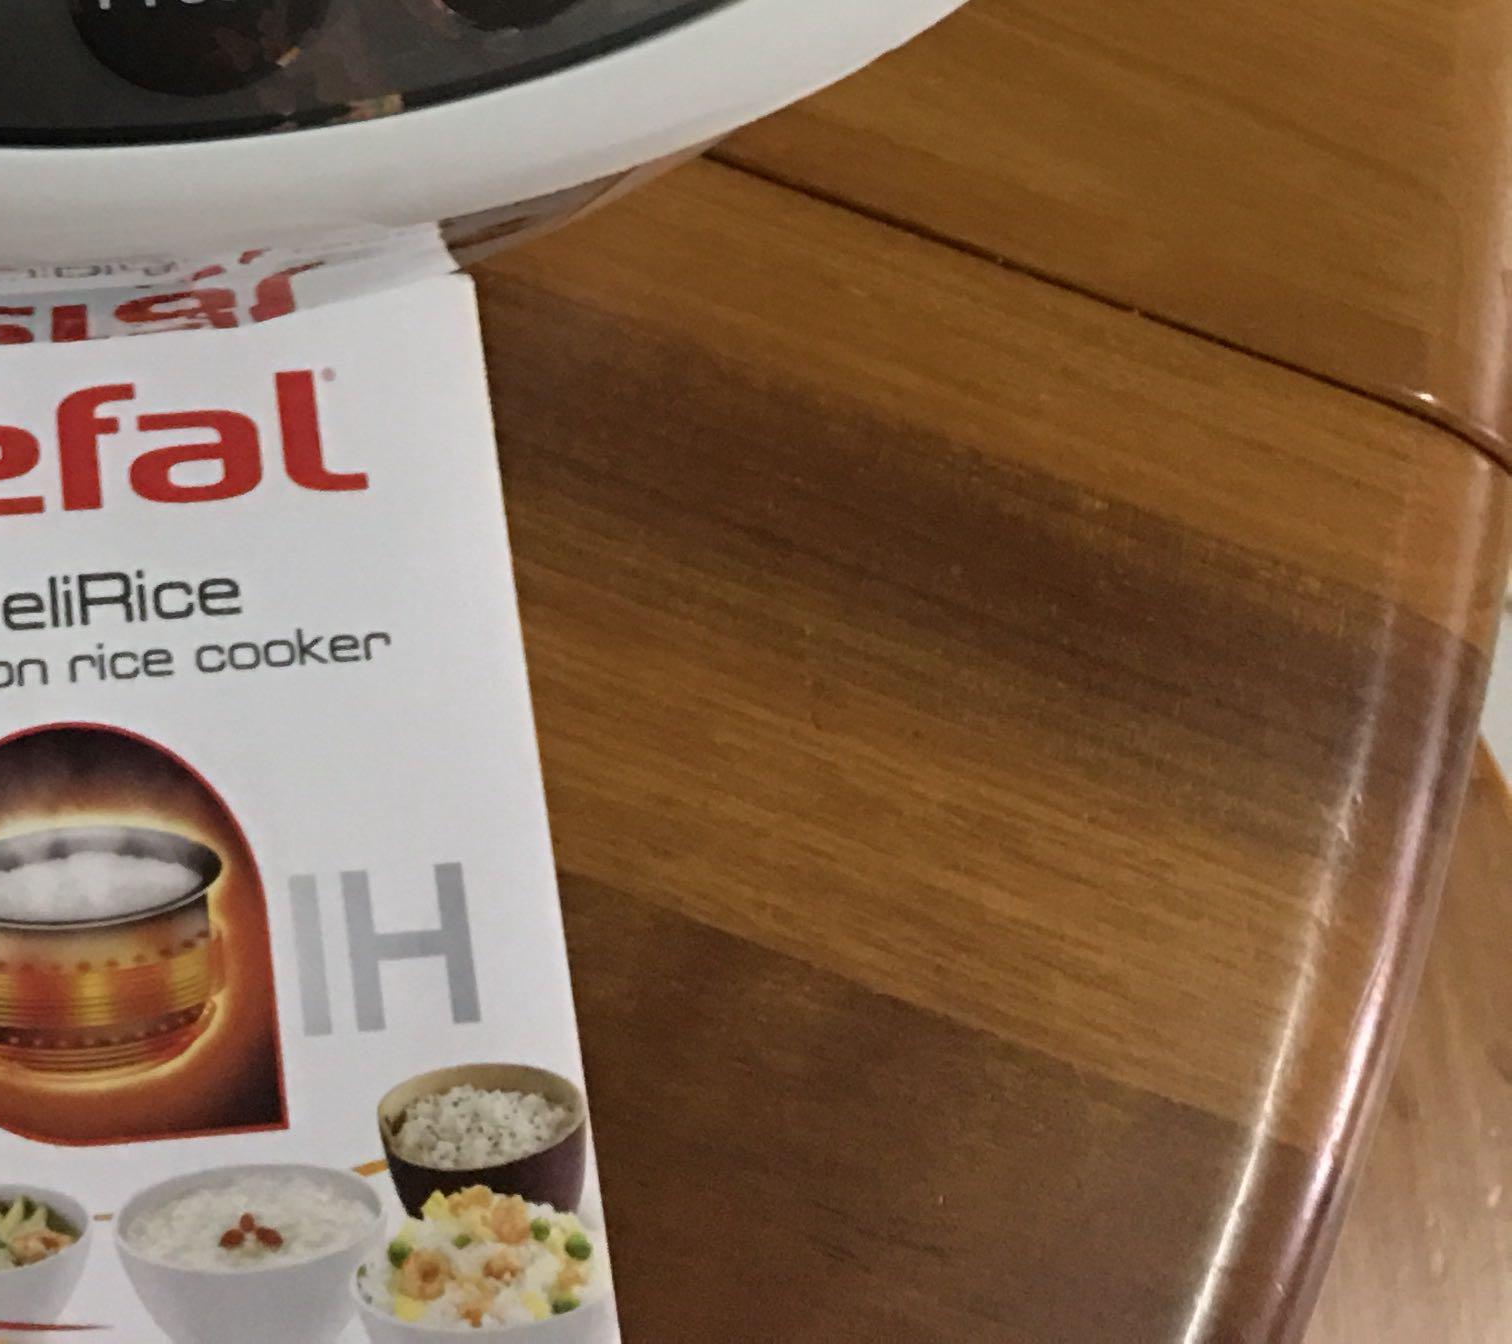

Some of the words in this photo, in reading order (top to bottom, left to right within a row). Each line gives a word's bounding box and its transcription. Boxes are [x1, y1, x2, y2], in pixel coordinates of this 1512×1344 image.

[69, 640, 175, 684] rice
[195, 628, 392, 677] cooker
[291, 861, 482, 1036] IH
